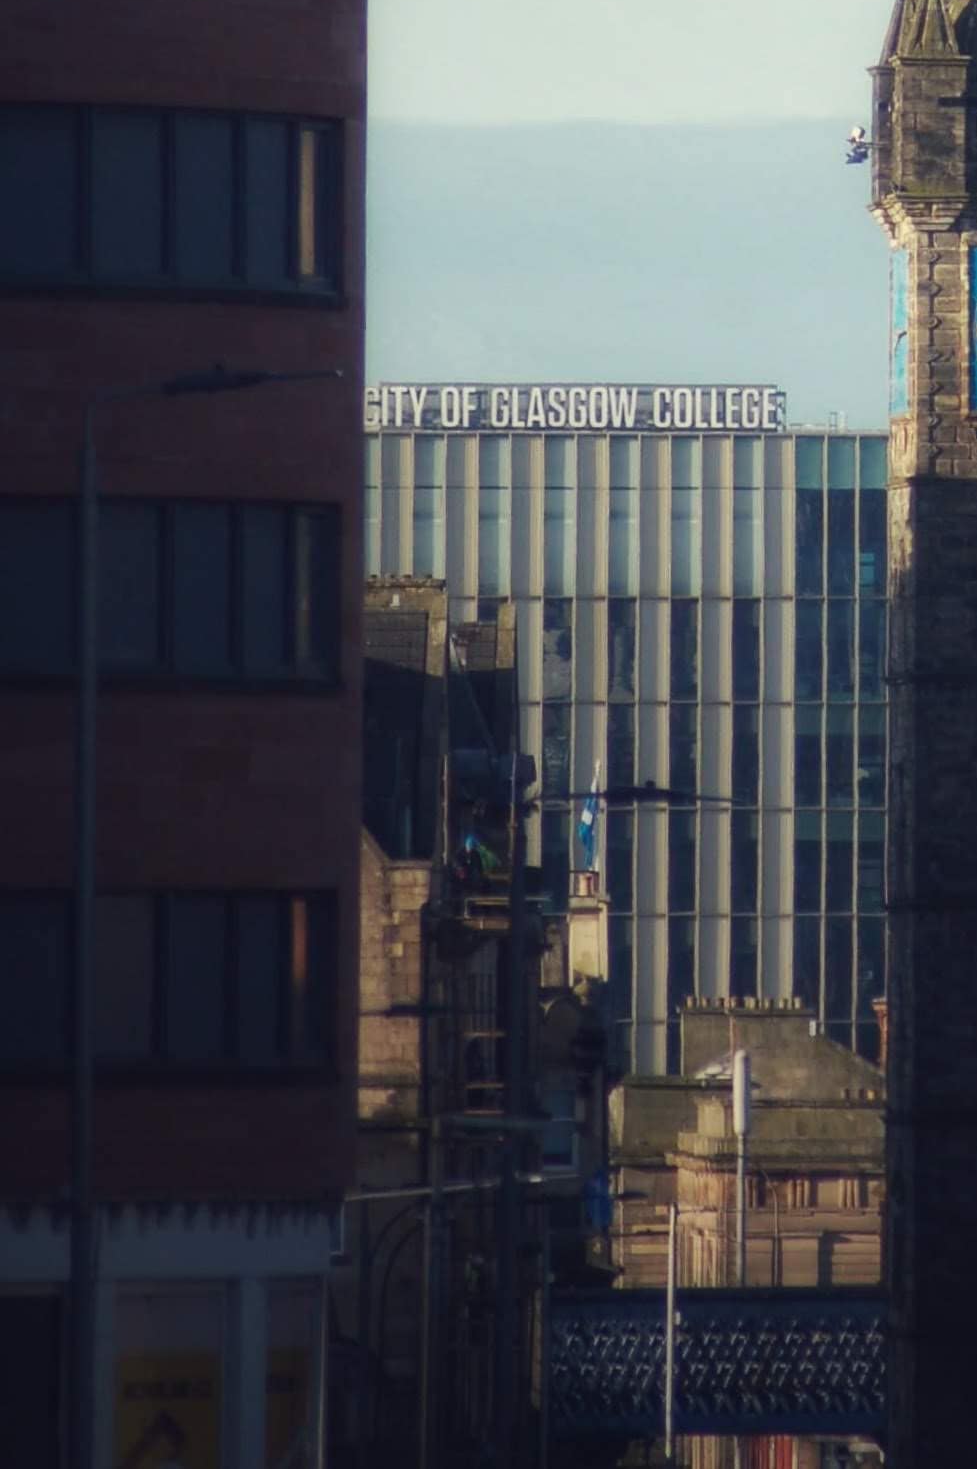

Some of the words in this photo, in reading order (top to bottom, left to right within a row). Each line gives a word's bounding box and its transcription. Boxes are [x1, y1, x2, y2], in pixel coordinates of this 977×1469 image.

[364, 386, 427, 428] CITY
[441, 386, 477, 428] OF
[491, 386, 638, 429] GLASGOW
[653, 387, 776, 429] COLLEGE
